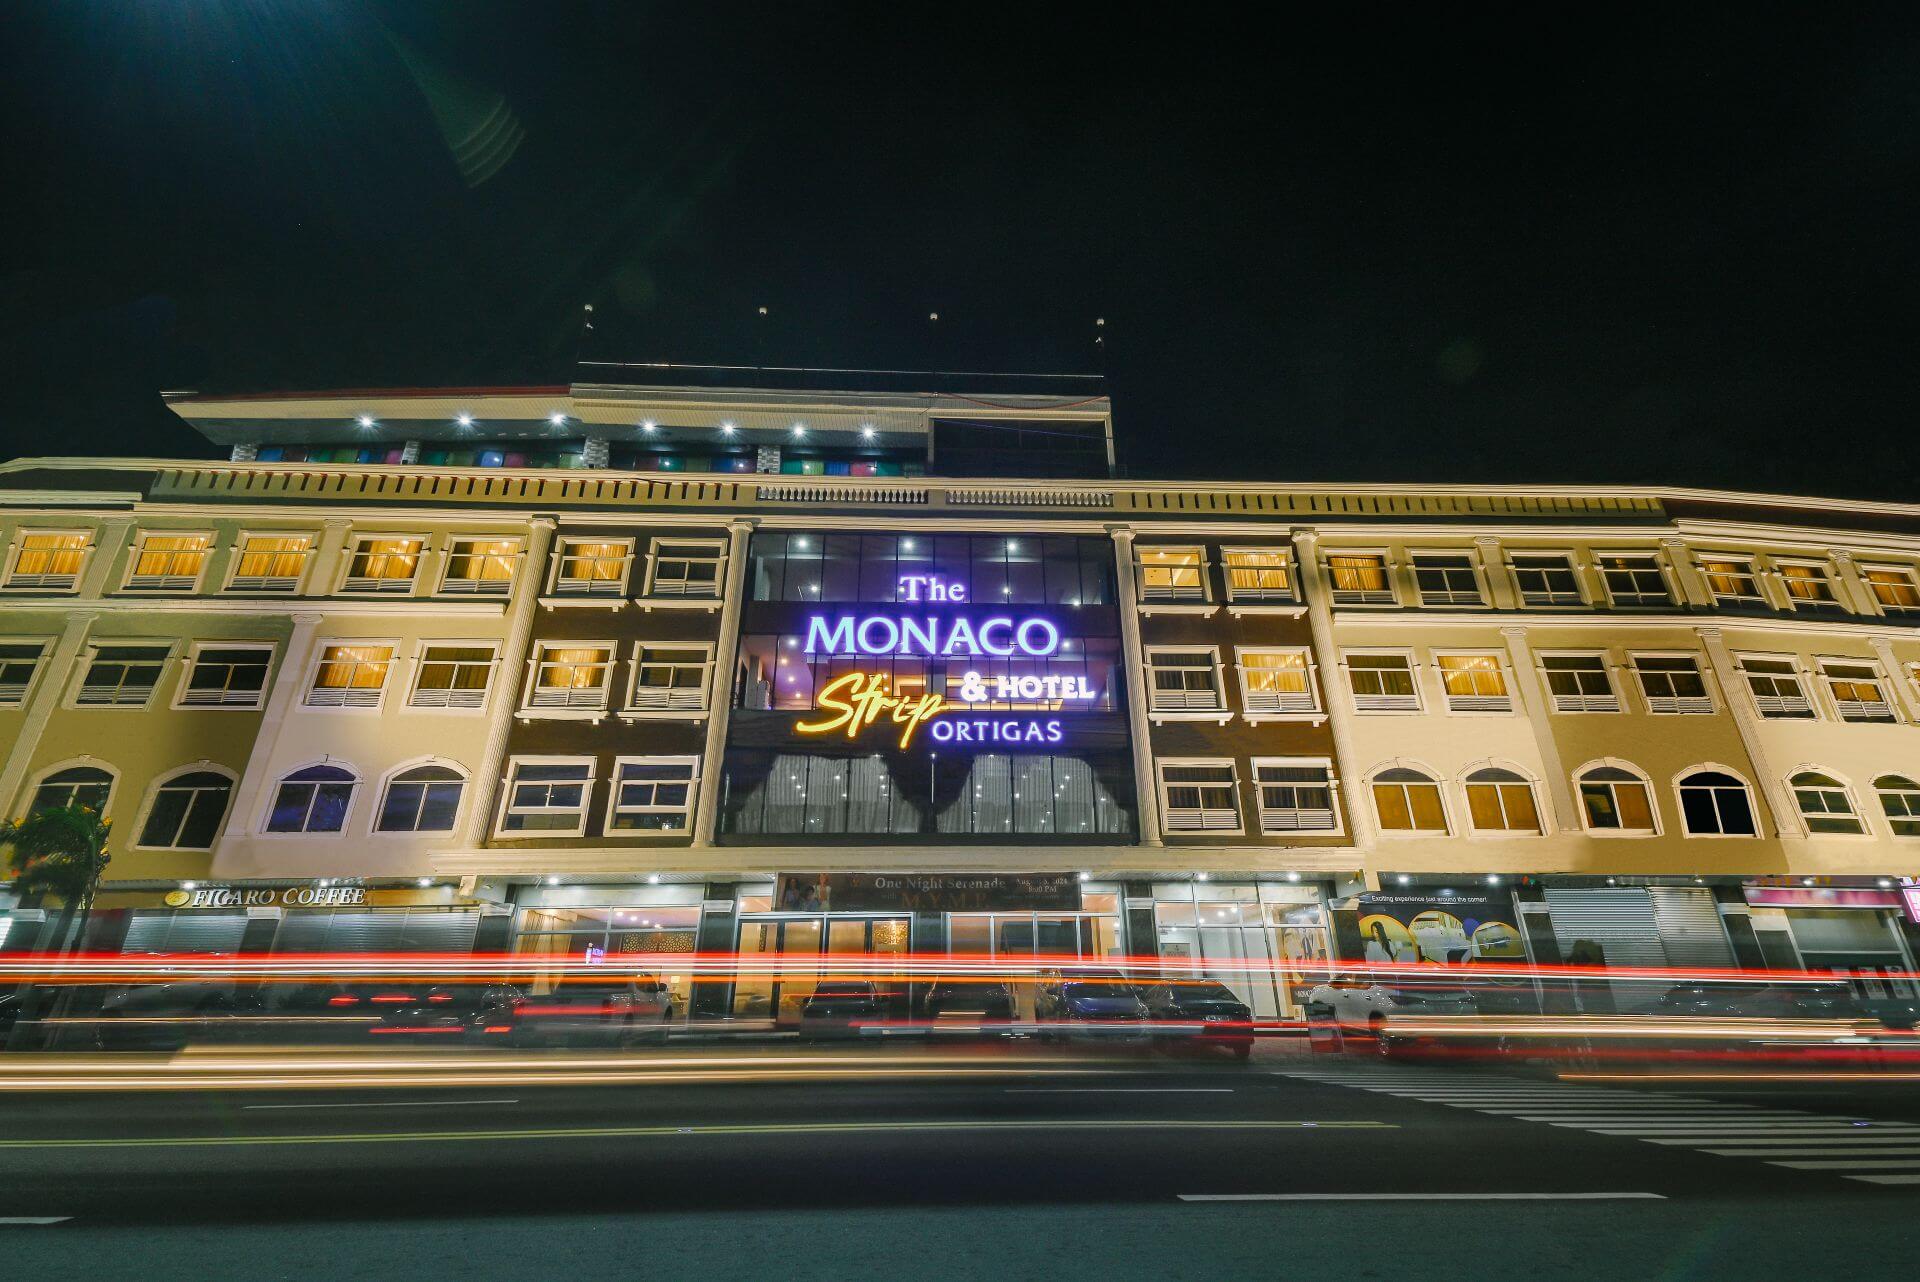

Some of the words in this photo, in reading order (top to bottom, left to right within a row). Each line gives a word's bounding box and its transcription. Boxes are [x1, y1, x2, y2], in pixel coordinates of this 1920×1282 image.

[899, 575, 965, 602] The
[804, 616, 1059, 656] MONACO
[960, 671, 988, 702] &
[996, 675, 1097, 700] HOTEL
[796, 672, 950, 750] Strip
[931, 720, 1063, 742] ORTIGAS
[875, 877, 902, 889] One
[906, 877, 943, 892] Night
[947, 877, 1006, 889] Serenade
[191, 888, 276, 907] FIGARO
[282, 887, 366, 905] COFFEE
[1371, 895, 1394, 903] Exciting
